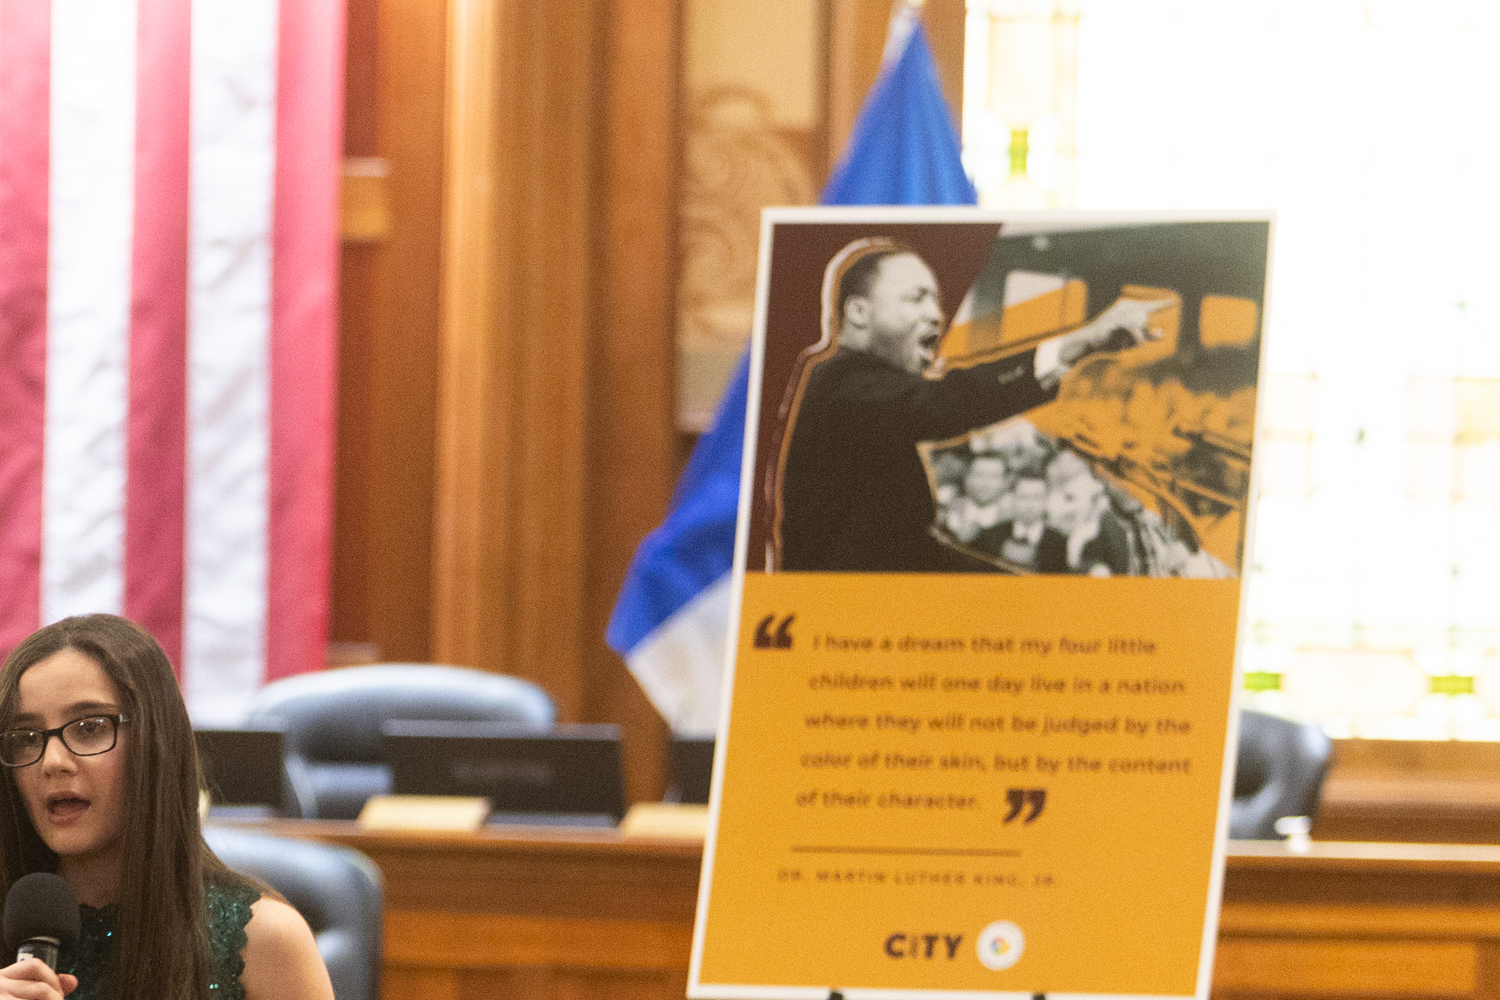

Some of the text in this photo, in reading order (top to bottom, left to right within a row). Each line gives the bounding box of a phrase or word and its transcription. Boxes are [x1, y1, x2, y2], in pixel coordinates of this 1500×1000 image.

[825, 634, 874, 653] have
[879, 639, 892, 653] a
[898, 634, 966, 654] dream
[971, 635, 1014, 654] that
[1020, 639, 1053, 658] my
[1059, 636, 1102, 656] four
[1107, 636, 1157, 655] little
[808, 670, 1185, 698] children will one day live in a nation
[804, 711, 1191, 738] where they will not be judged by the
[799, 750, 1191, 778] color of their skin, but by the content
[796, 788, 818, 808] of
[822, 789, 871, 809] their
